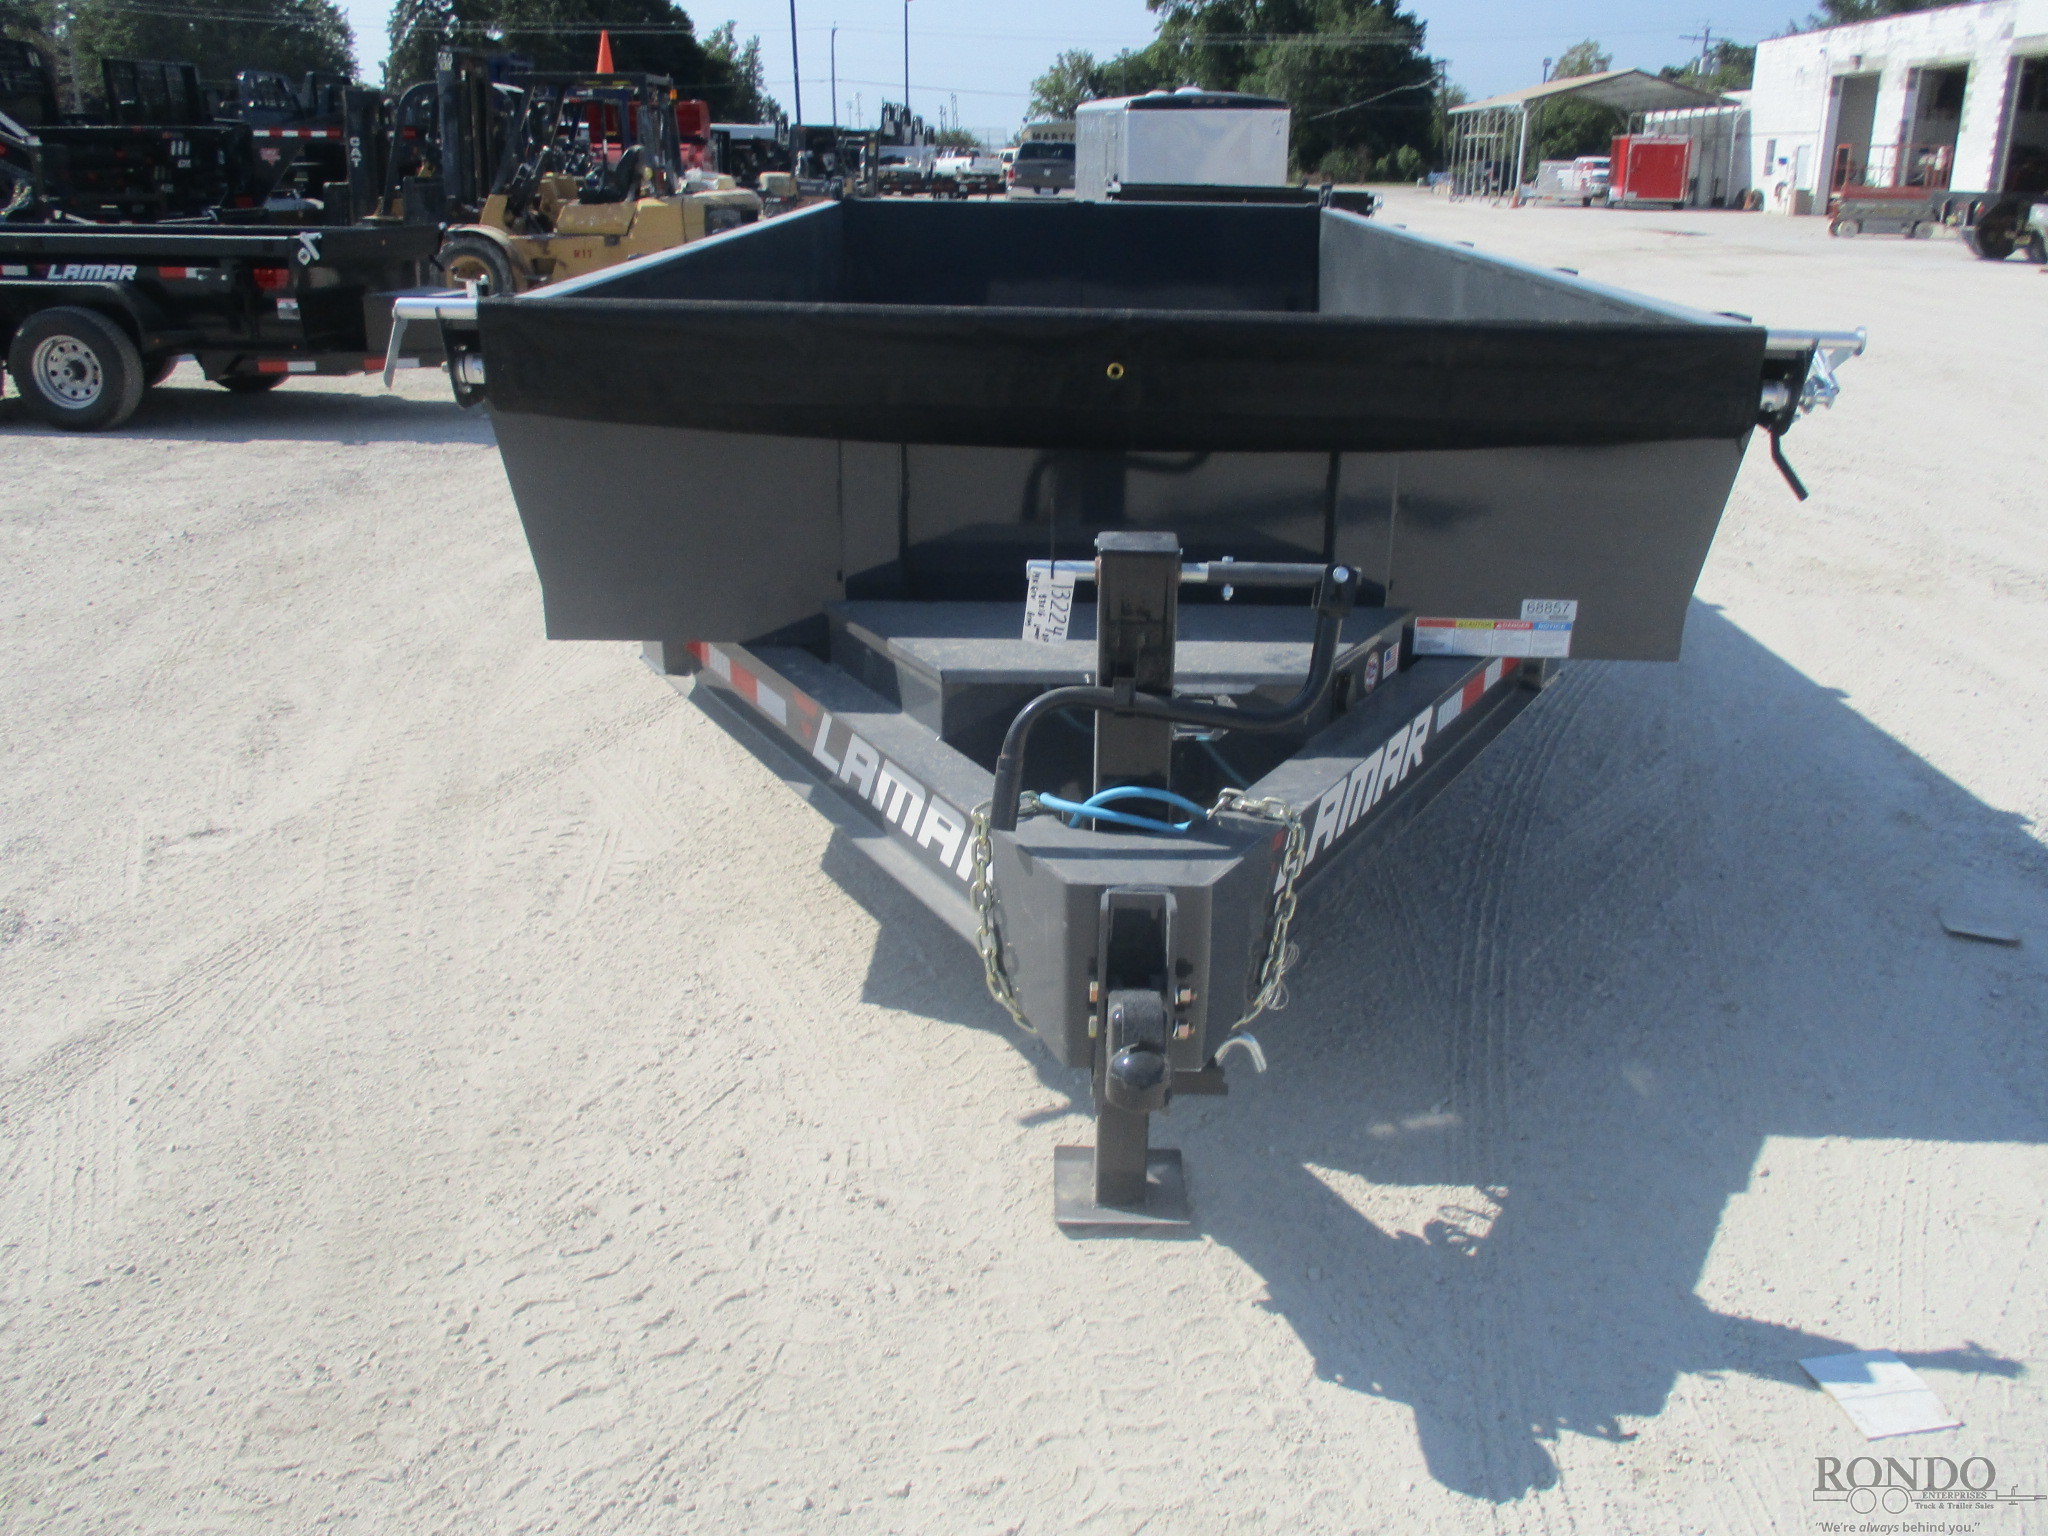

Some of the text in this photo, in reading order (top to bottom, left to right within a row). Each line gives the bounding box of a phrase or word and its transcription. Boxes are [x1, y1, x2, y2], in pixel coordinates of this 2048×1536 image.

[349, 136, 362, 168] CAT
[46, 263, 138, 281] LAMAR
[1045, 584, 1074, 636] 13224
[1526, 600, 1570, 615] 68857
